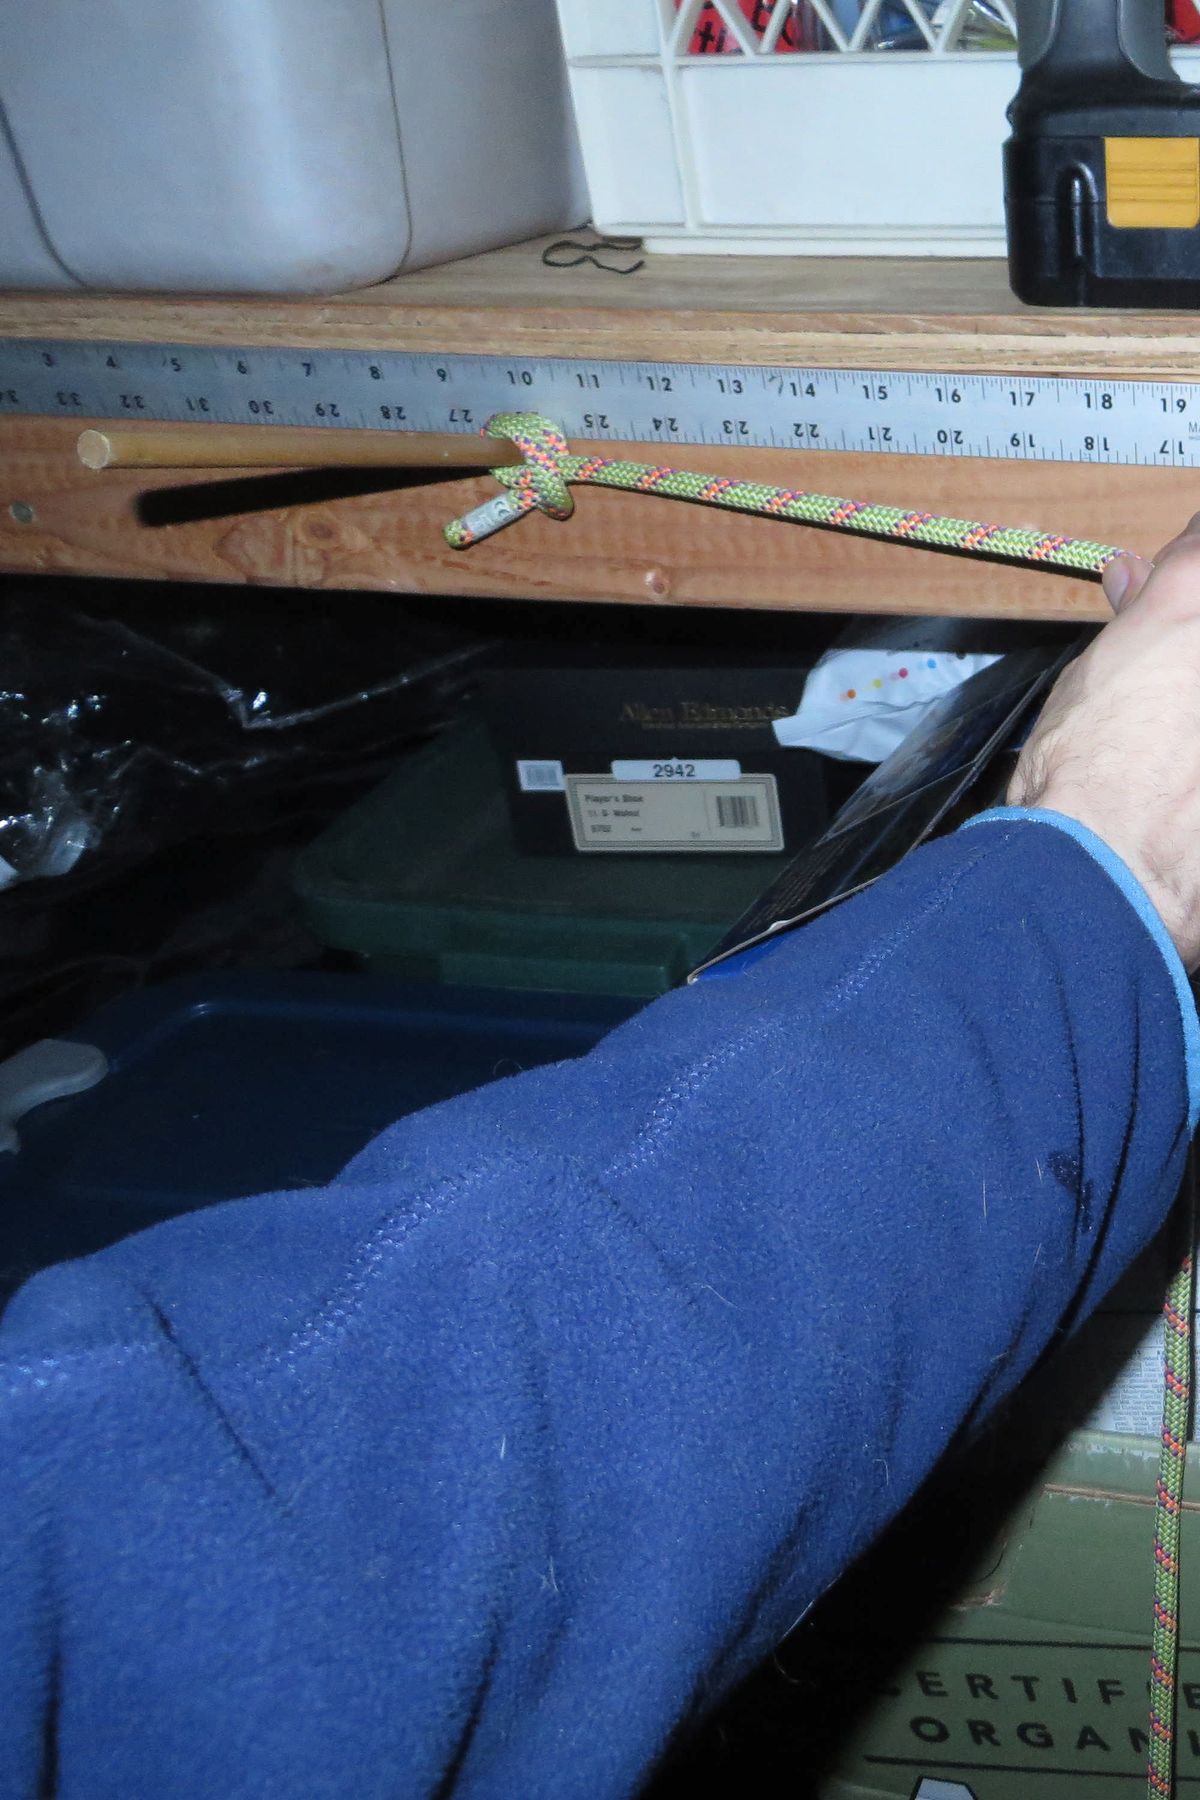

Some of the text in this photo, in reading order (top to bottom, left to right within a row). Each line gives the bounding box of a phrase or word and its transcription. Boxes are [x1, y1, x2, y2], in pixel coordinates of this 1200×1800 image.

[171, 357, 182, 372] 5
[236, 360, 248, 375] 6
[301, 362, 313, 378] 7
[369, 366, 381, 380] 8
[436, 368, 448, 383] 9
[506, 370, 533, 386] 10
[576, 373, 601, 389] 11
[646, 376, 673, 393] 12
[718, 378, 745, 395] 13
[789, 381, 816, 398] 14
[862, 384, 889, 401] 15
[936, 388, 962, 404] 16
[1009, 391, 1036, 407] 17
[1084, 393, 1114, 411] 18
[1159, 397, 1188, 414] 19
[55, 390, 81, 406] 33
[119, 393, 145, 410] 32
[185, 396, 210, 413] 31
[248, 399, 275, 416] 30
[313, 402, 341, 419] 29
[379, 404, 407, 421] 28
[448, 408, 474, 424] 27
[583, 413, 609, 430] 25
[652, 416, 679, 433] 24
[722, 418, 749, 436] 23
[793, 422, 820, 439] 22
[868, 425, 893, 442] 21
[936, 428, 964, 445] 20
[1010, 431, 1036, 449] 19
[1084, 434, 1111, 452] 18
[1159, 438, 1185, 456] 17
[652, 763, 696, 778] 2942
